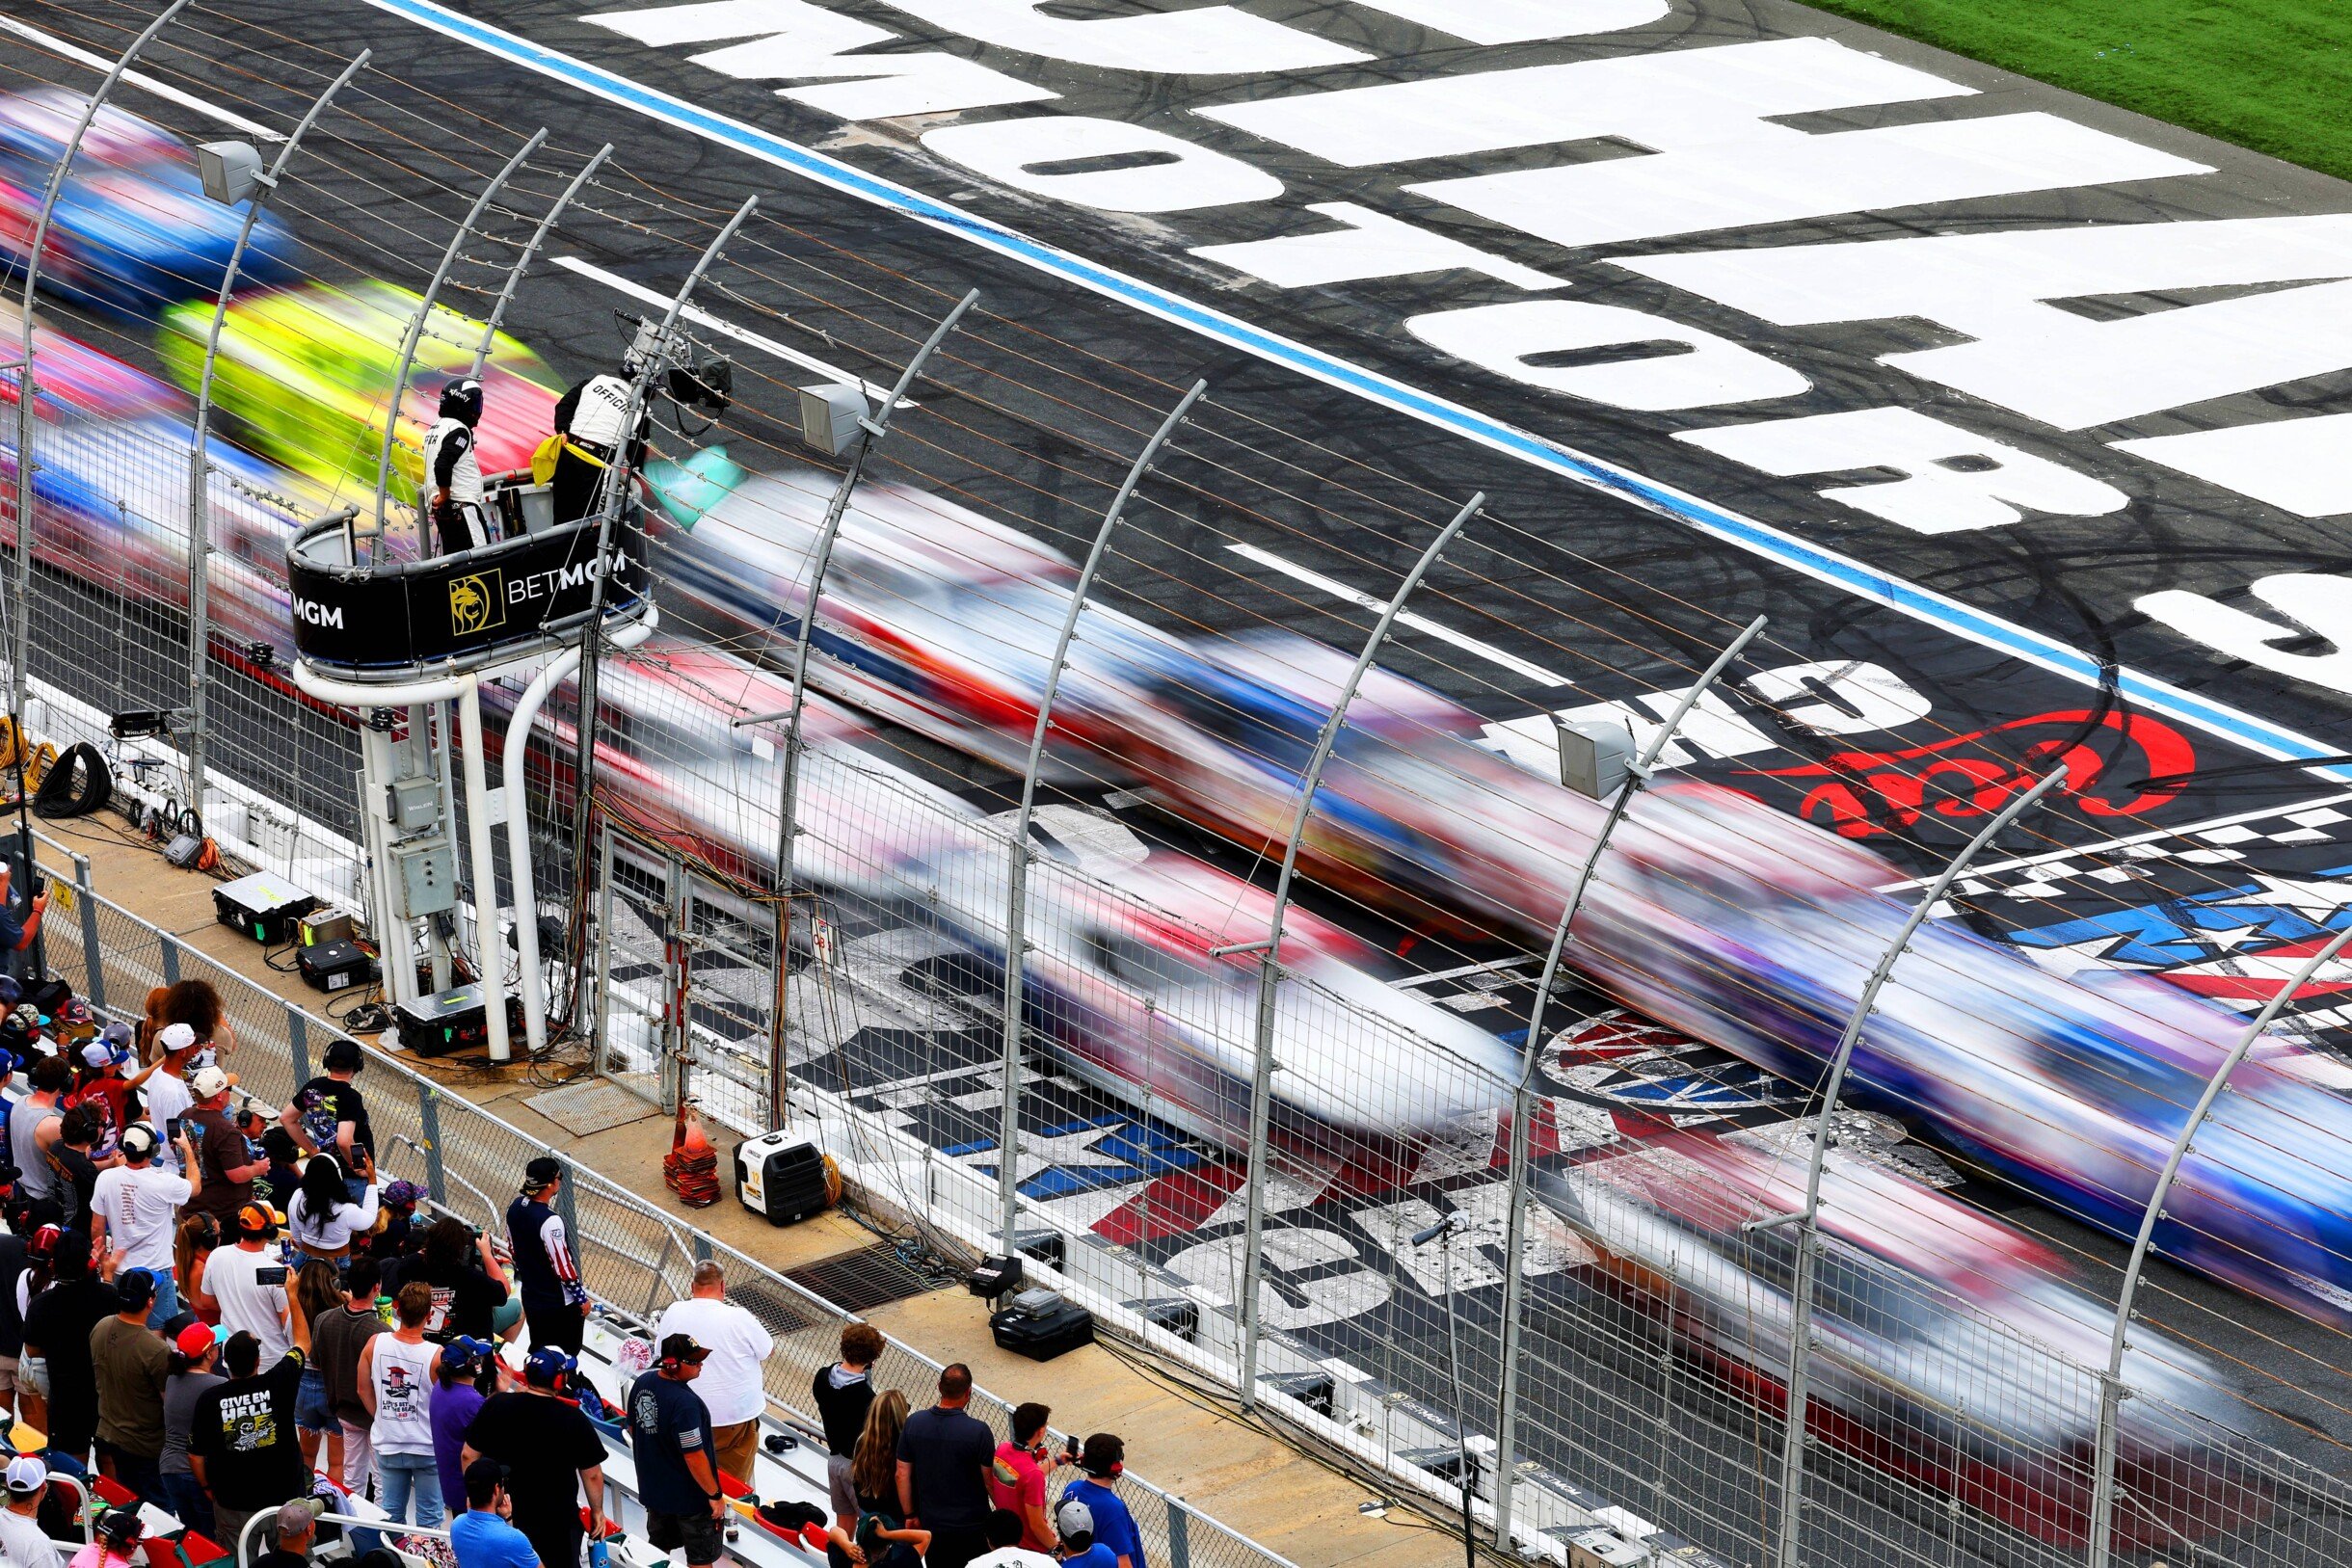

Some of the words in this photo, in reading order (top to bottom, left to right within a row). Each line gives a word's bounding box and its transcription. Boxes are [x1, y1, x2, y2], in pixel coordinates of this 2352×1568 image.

[448, 387, 471, 403] xfinity
[219, 1394, 252, 1410] GIVE
[252, 1390, 271, 1404] EM
[221, 1401, 273, 1423] HELL
